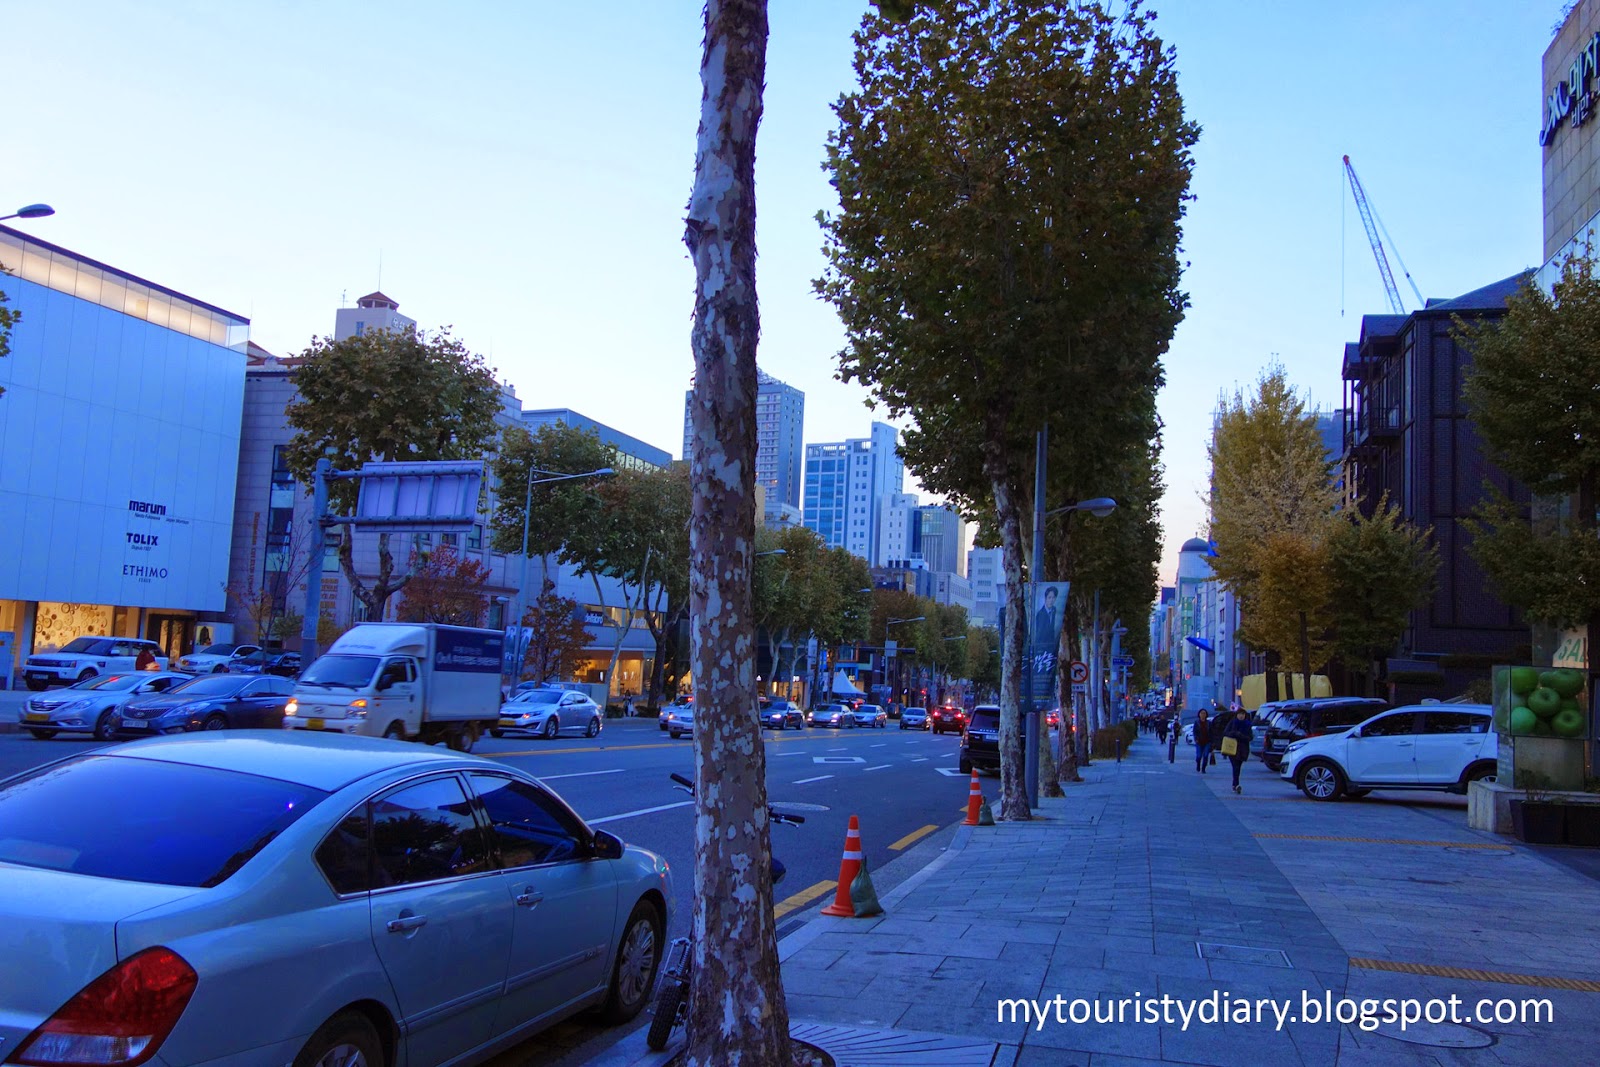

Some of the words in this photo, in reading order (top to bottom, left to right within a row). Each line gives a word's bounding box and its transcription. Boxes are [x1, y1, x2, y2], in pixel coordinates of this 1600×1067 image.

[128, 500, 166, 516] maruni
[126, 532, 158, 546] TOLIX
[123, 565, 168, 578] ETHIMO
